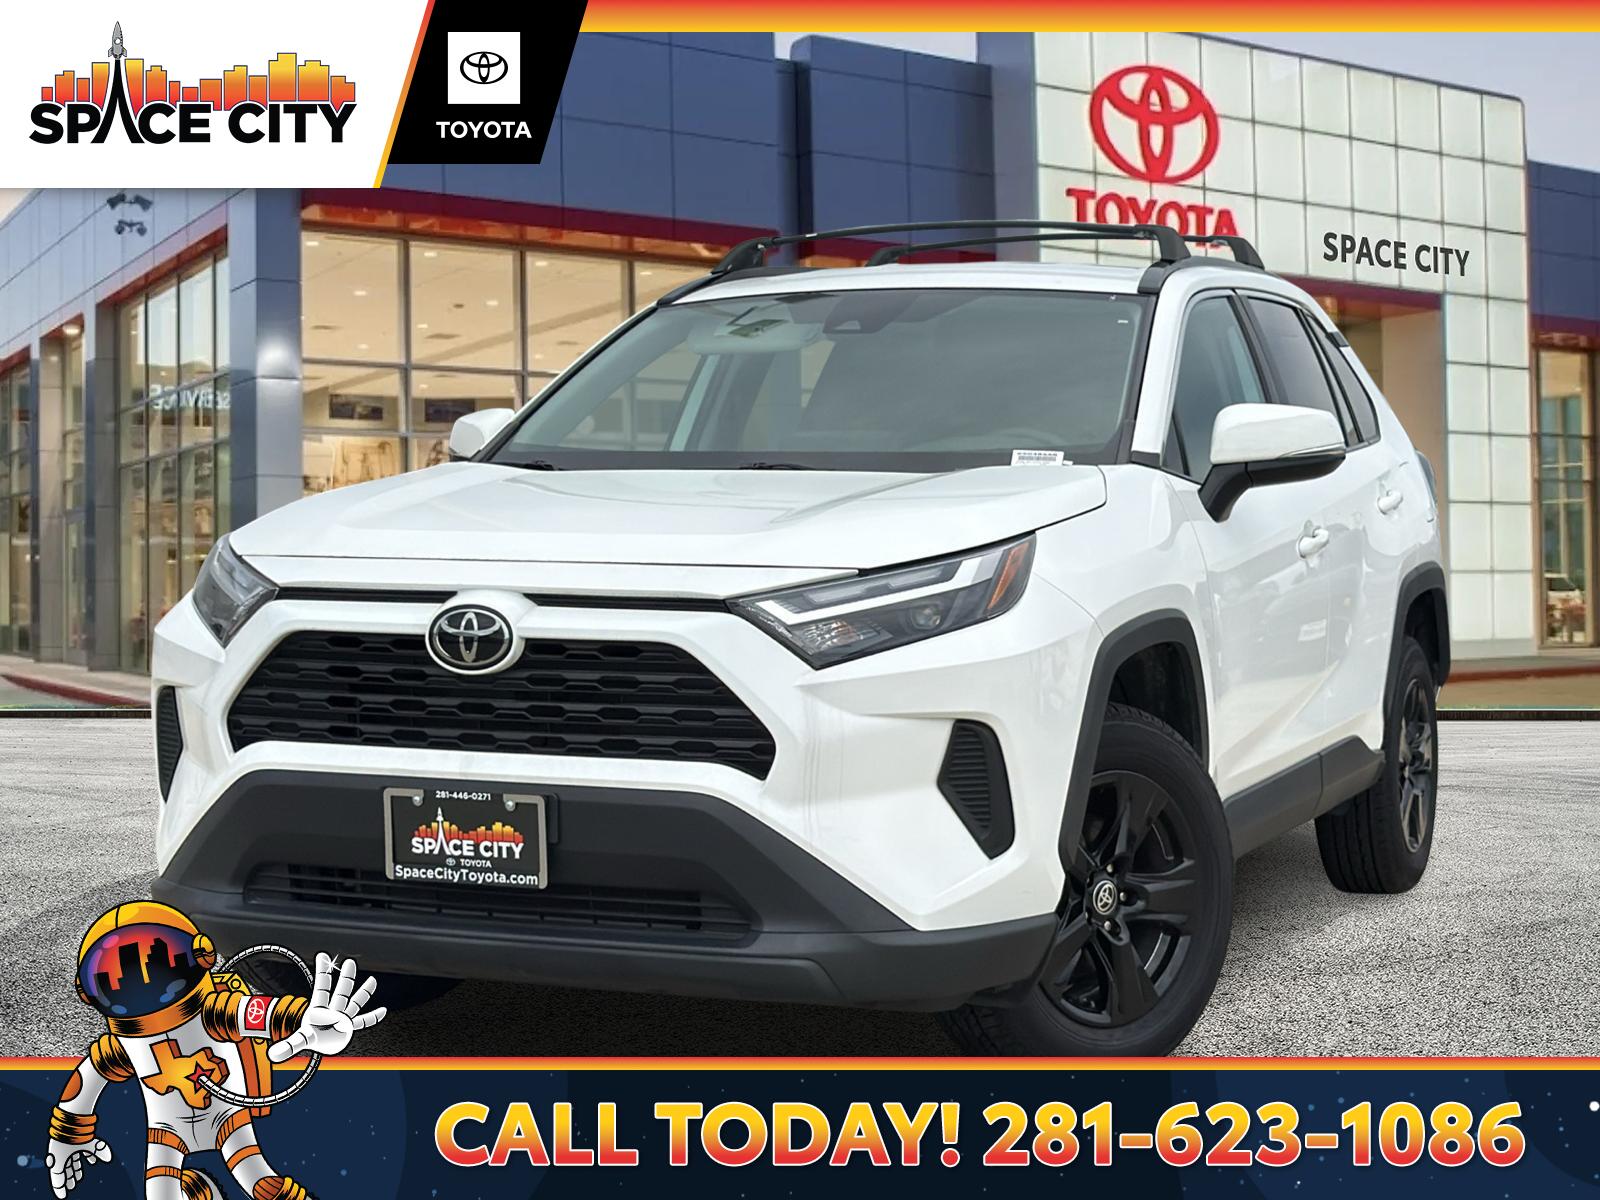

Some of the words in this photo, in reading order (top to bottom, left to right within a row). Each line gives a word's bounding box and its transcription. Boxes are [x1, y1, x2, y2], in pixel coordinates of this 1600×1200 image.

[1065, 187, 1238, 248] TOYOTA
[1323, 231, 1407, 271] SPACE
[1414, 243, 1471, 278] CITY
[435, 790, 492, 801] 281-446-0271
[479, 840, 525, 860] CITY
[459, 858, 493, 868] TOYOTA
[395, 864, 539, 886] SpaceCityToyota.com
